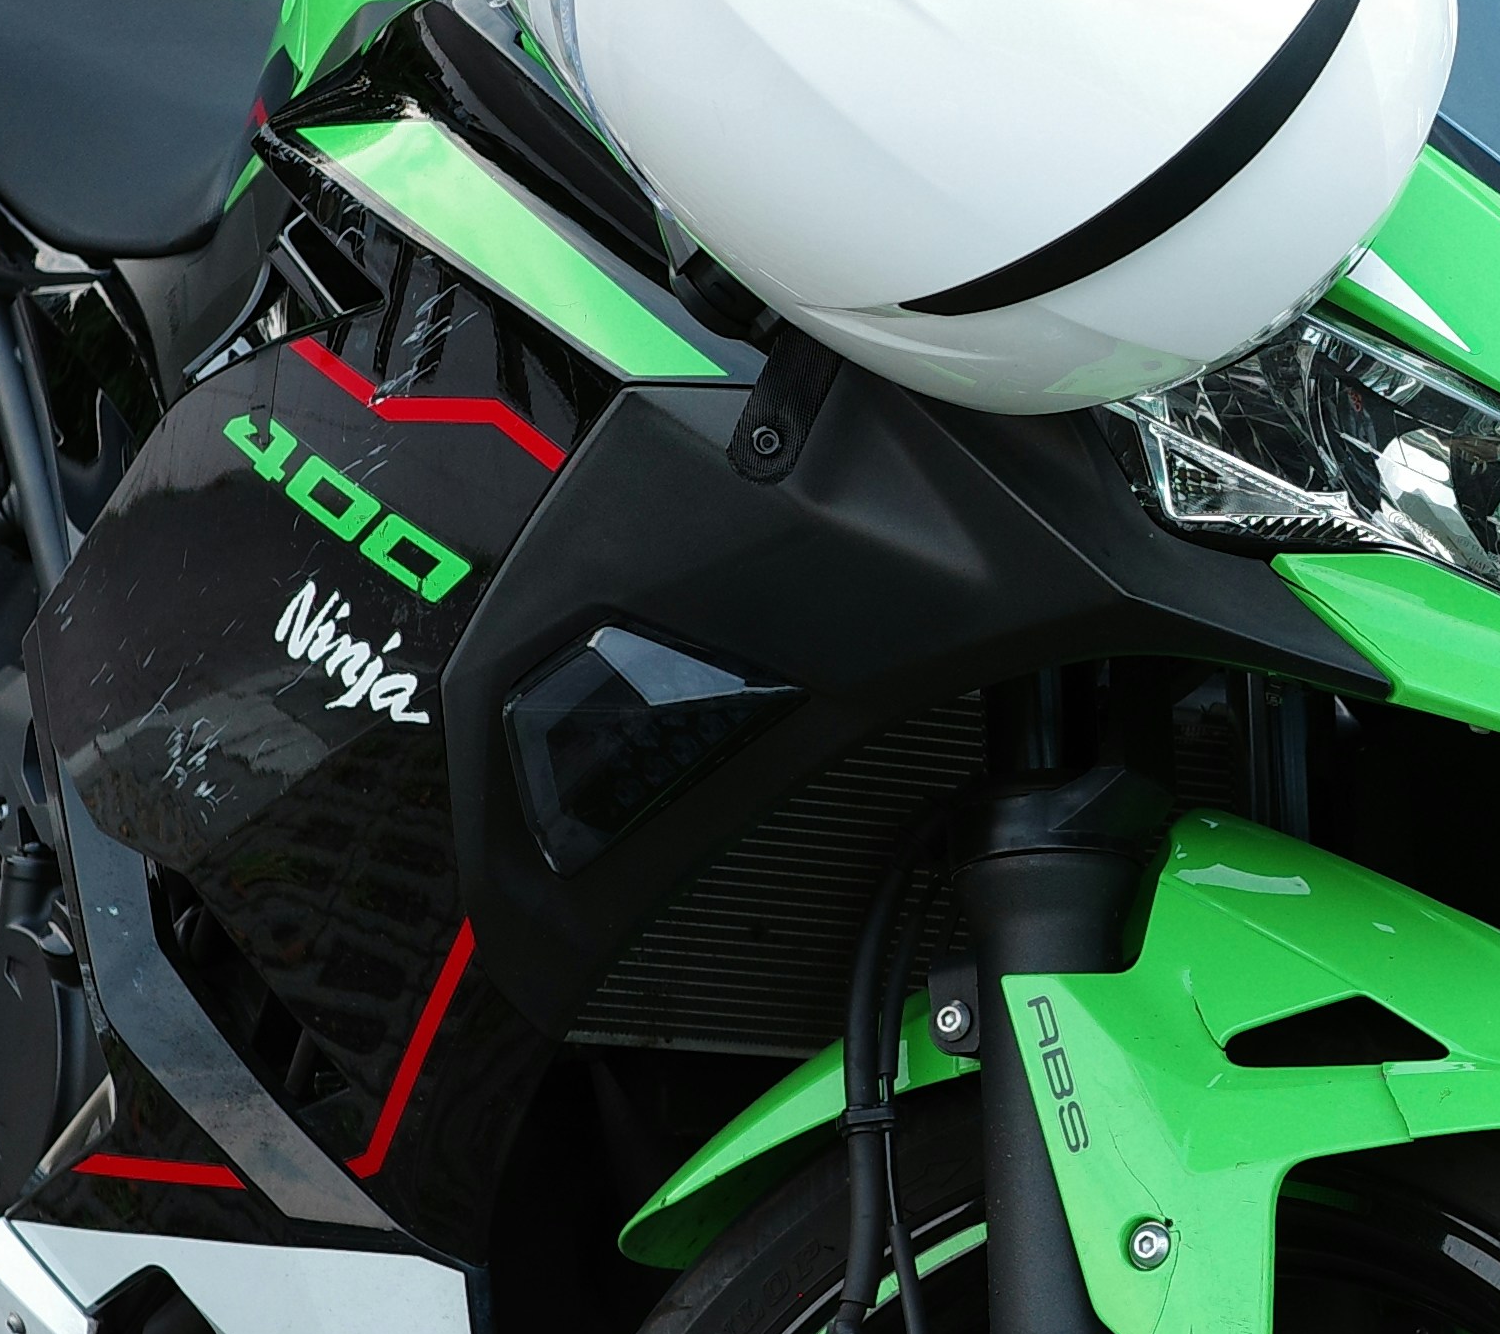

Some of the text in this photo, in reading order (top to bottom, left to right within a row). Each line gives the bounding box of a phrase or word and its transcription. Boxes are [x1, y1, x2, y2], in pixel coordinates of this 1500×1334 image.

[222, 413, 474, 605] 400
[274, 580, 431, 726] Ninja
[1025, 994, 1090, 1154] ABS
